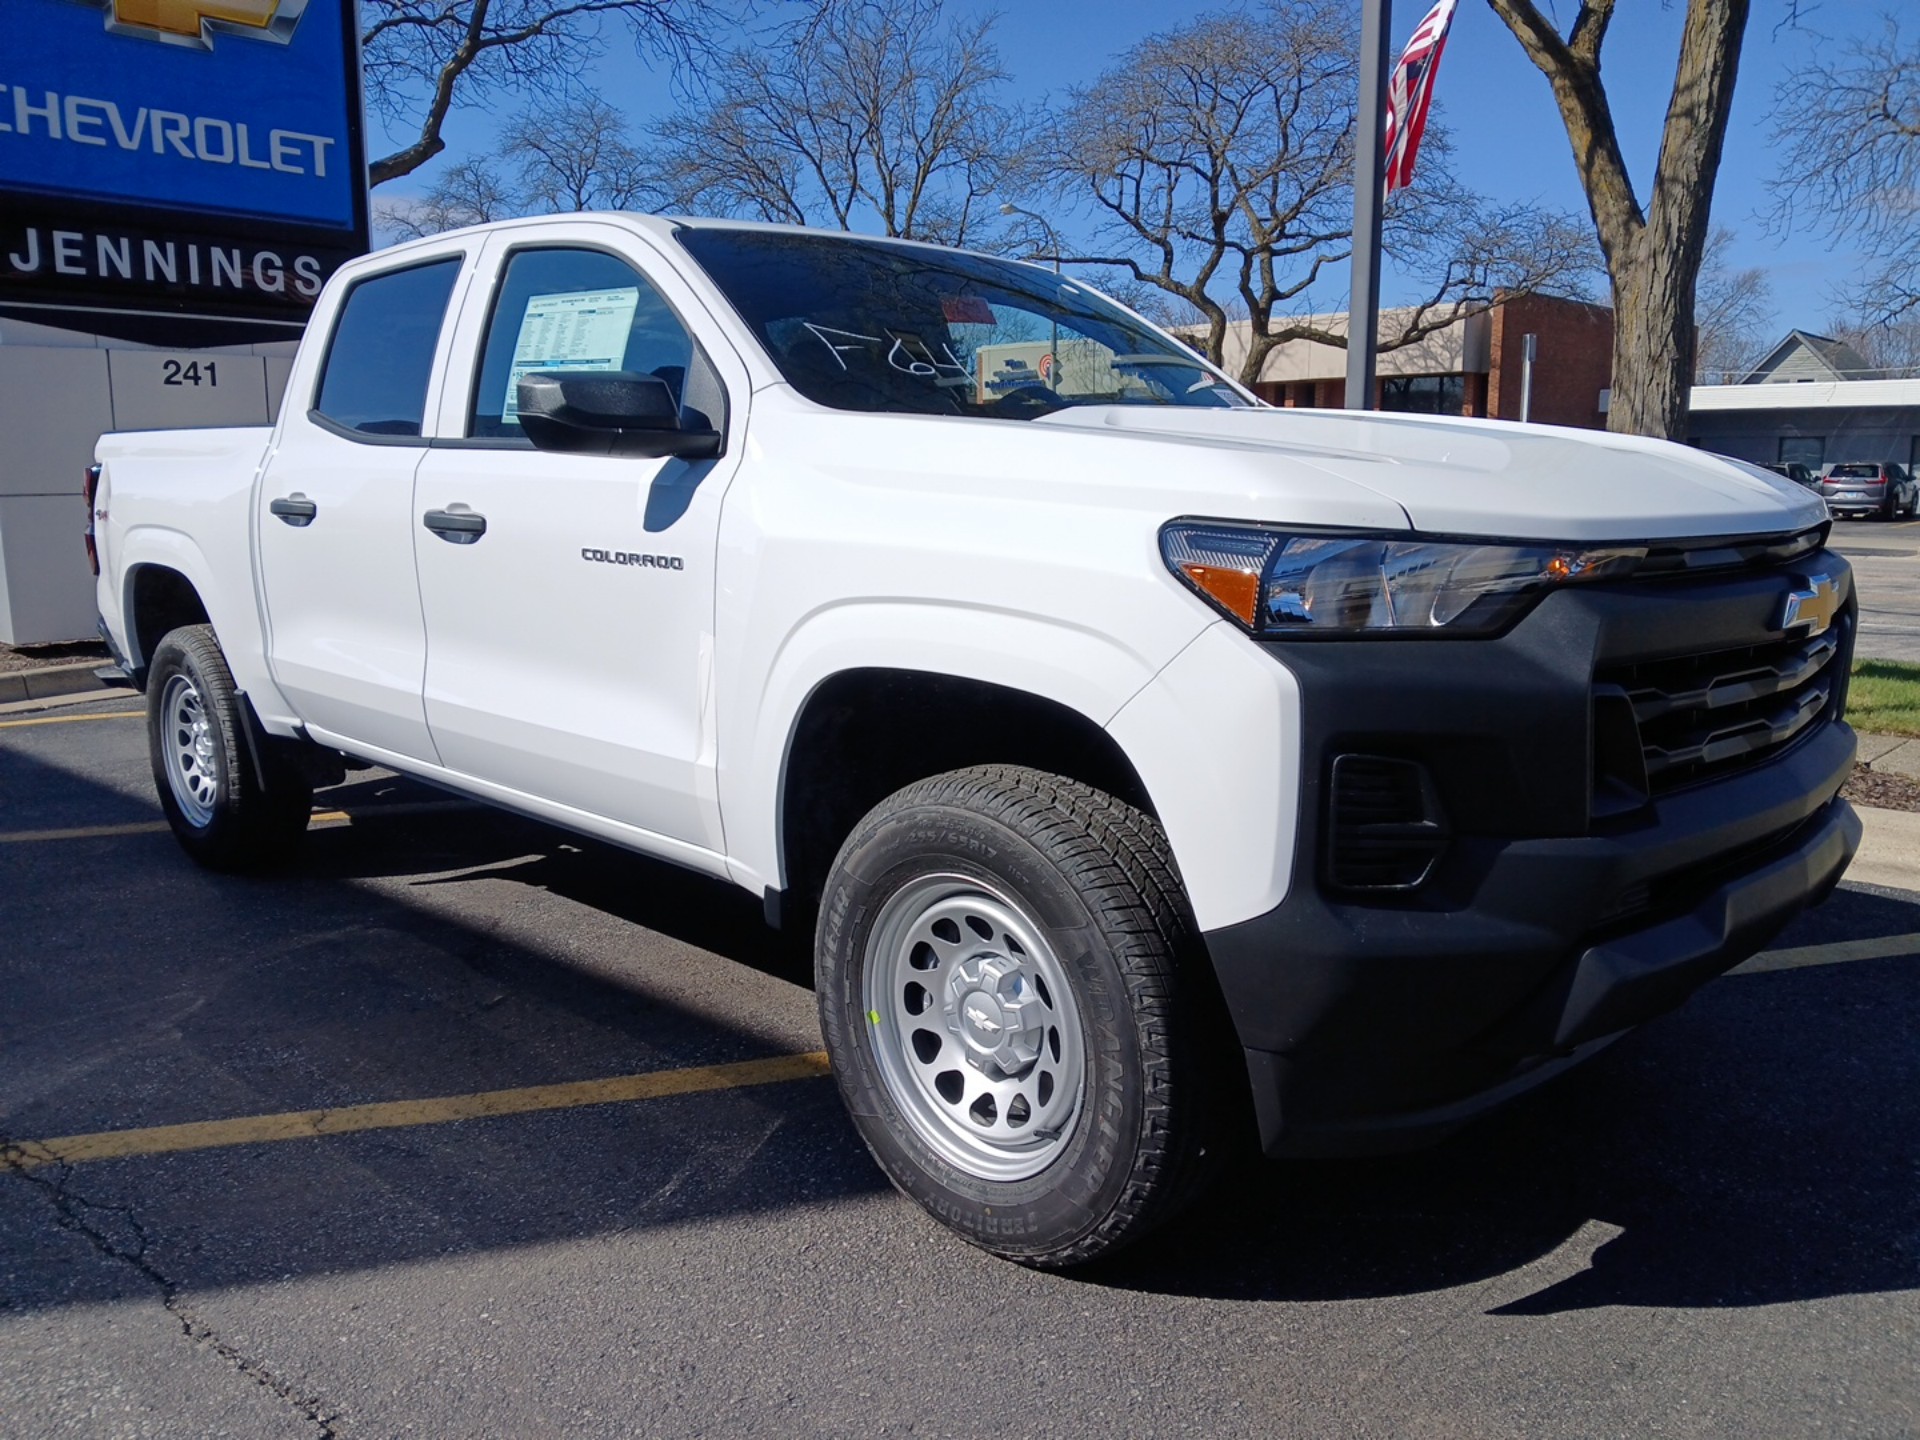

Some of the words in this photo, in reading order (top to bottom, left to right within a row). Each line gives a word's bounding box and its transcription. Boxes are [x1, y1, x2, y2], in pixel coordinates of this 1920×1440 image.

[0, 84, 335, 177] HEVROLET
[9, 227, 322, 296] JENNINGS
[163, 359, 217, 387] 241
[581, 548, 684, 571] COLORADO
[1076, 950, 1125, 1193] WRANGLER
[924, 1192, 1039, 1235] TERRITORY
